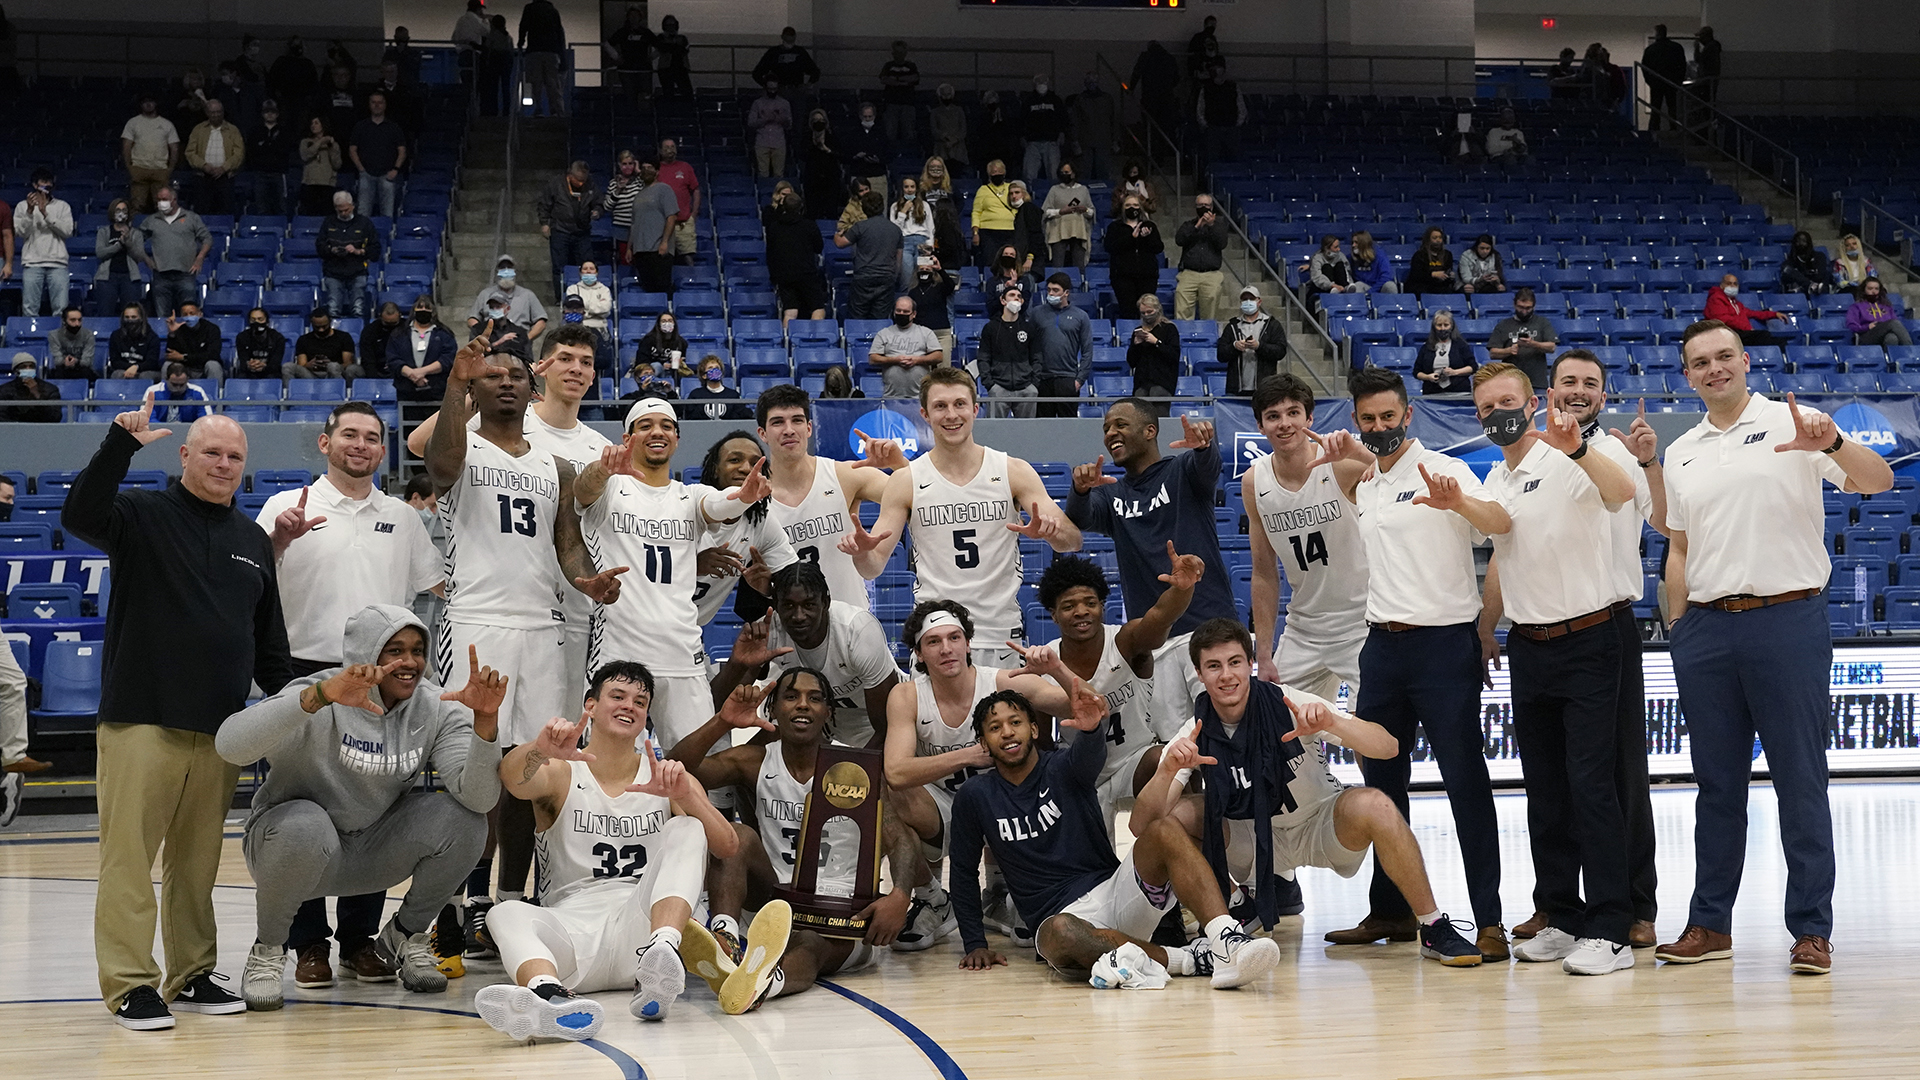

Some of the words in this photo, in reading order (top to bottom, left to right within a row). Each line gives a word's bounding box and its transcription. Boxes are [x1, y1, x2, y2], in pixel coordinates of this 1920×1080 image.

[1743, 430, 1769, 445] LMU
[470, 465, 558, 503] LINCOLN
[497, 494, 536, 538] 13
[612, 512, 694, 541] LINCOLN
[918, 500, 1008, 527] LINCOLN
[1263, 499, 1341, 533] LINCOLN
[231, 554, 261, 569] LINCOLN
[643, 542, 673, 585] 11
[953, 528, 980, 569] 5
[1288, 530, 1329, 571] 14
[342, 732, 384, 755] LINCOLN
[826, 783, 868, 800] NCAA
[574, 809, 665, 838] LINCOLN
[996, 815, 1039, 842] ALL
[1037, 799, 1062, 832] IN
[592, 842, 648, 879] 32
[793, 912, 827, 925] REGIONAL
